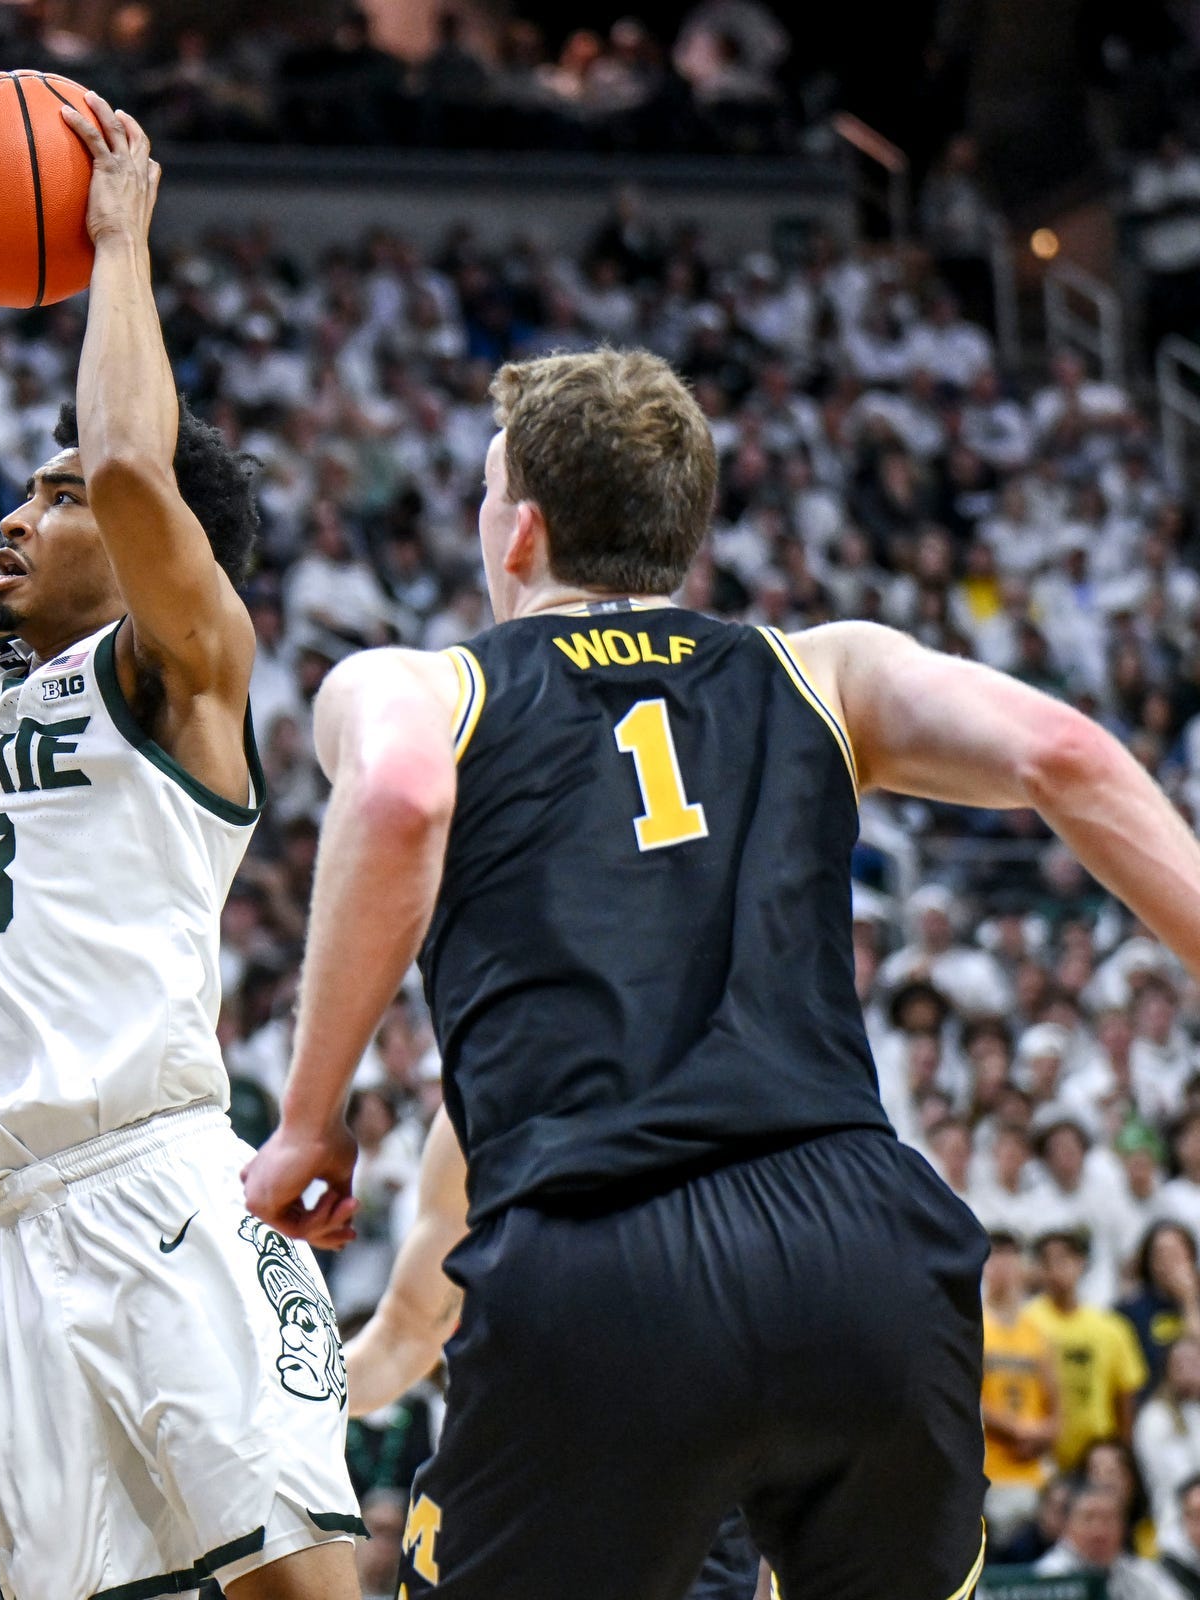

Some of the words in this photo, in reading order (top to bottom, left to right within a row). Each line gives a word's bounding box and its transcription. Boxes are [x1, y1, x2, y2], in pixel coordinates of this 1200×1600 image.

[552, 629, 696, 670] WOLF
[613, 698, 709, 852] 1
[402, 1493, 442, 1587] M
